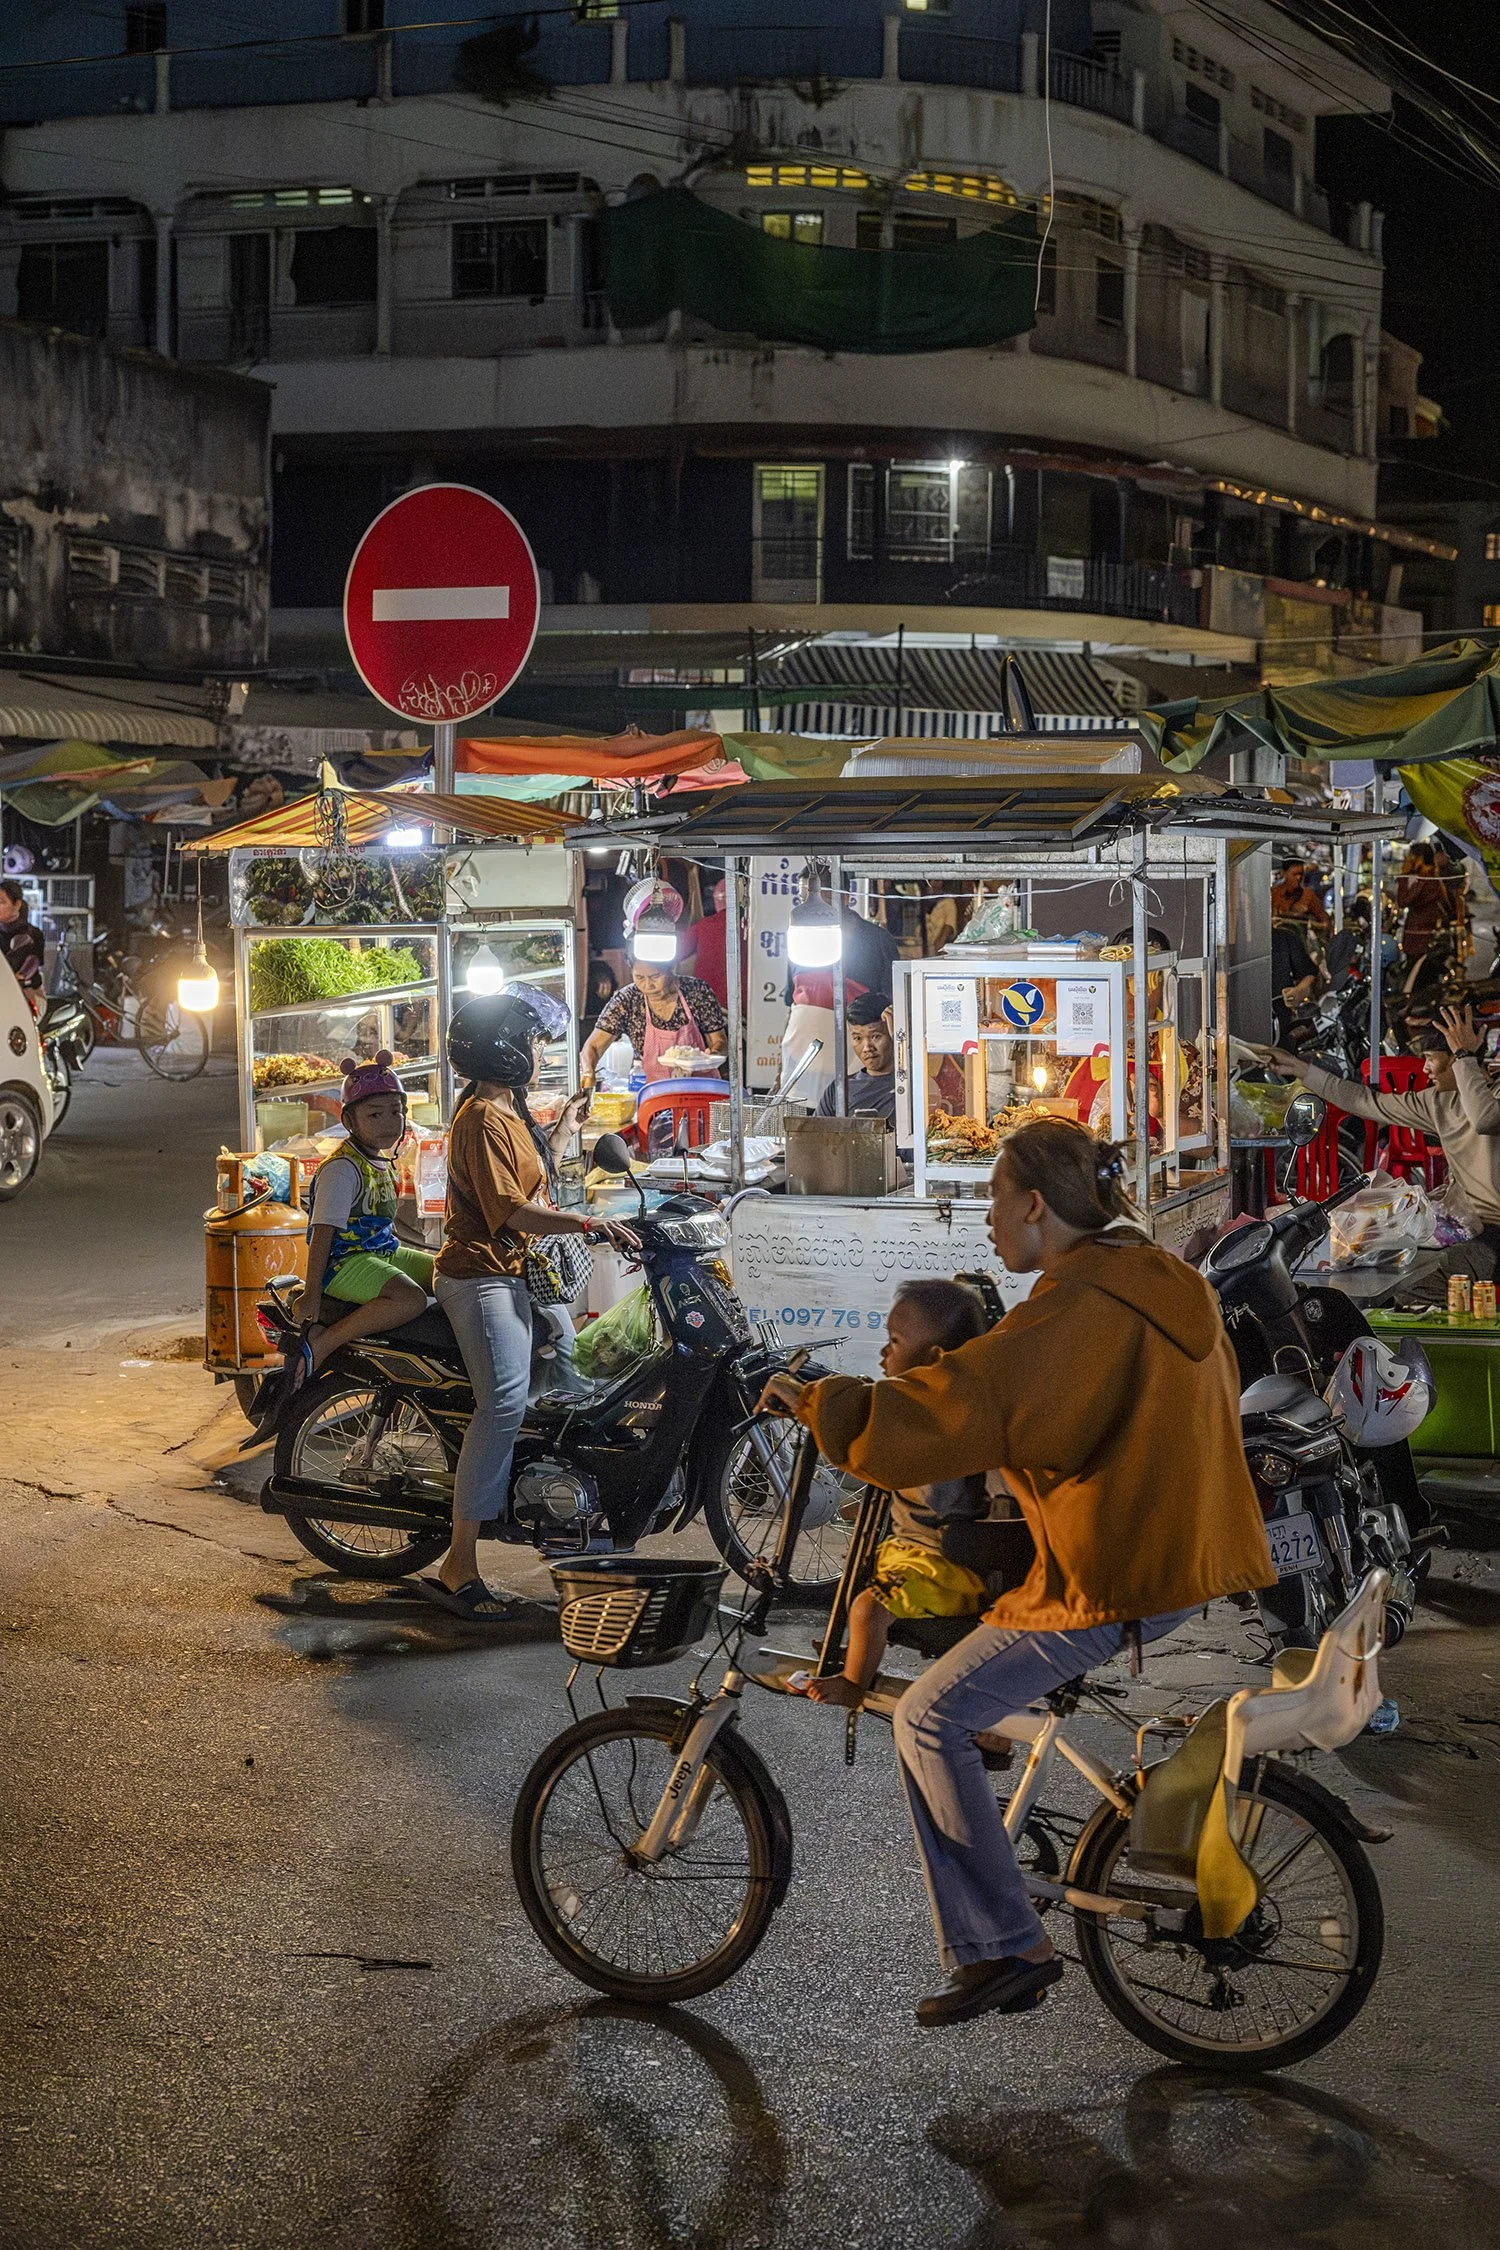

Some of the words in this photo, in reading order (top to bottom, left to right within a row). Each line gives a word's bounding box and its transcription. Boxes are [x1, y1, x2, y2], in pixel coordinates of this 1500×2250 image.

[746, 1307, 826, 1327] EL:097
[831, 1309, 861, 1329] 76
[866, 1311, 888, 1330] 9
[623, 1400, 663, 1411] HONDA
[1271, 1534, 1317, 1565] 4272
[1279, 1564, 1299, 1574] PENH
[669, 1761, 692, 1799] Jeep
